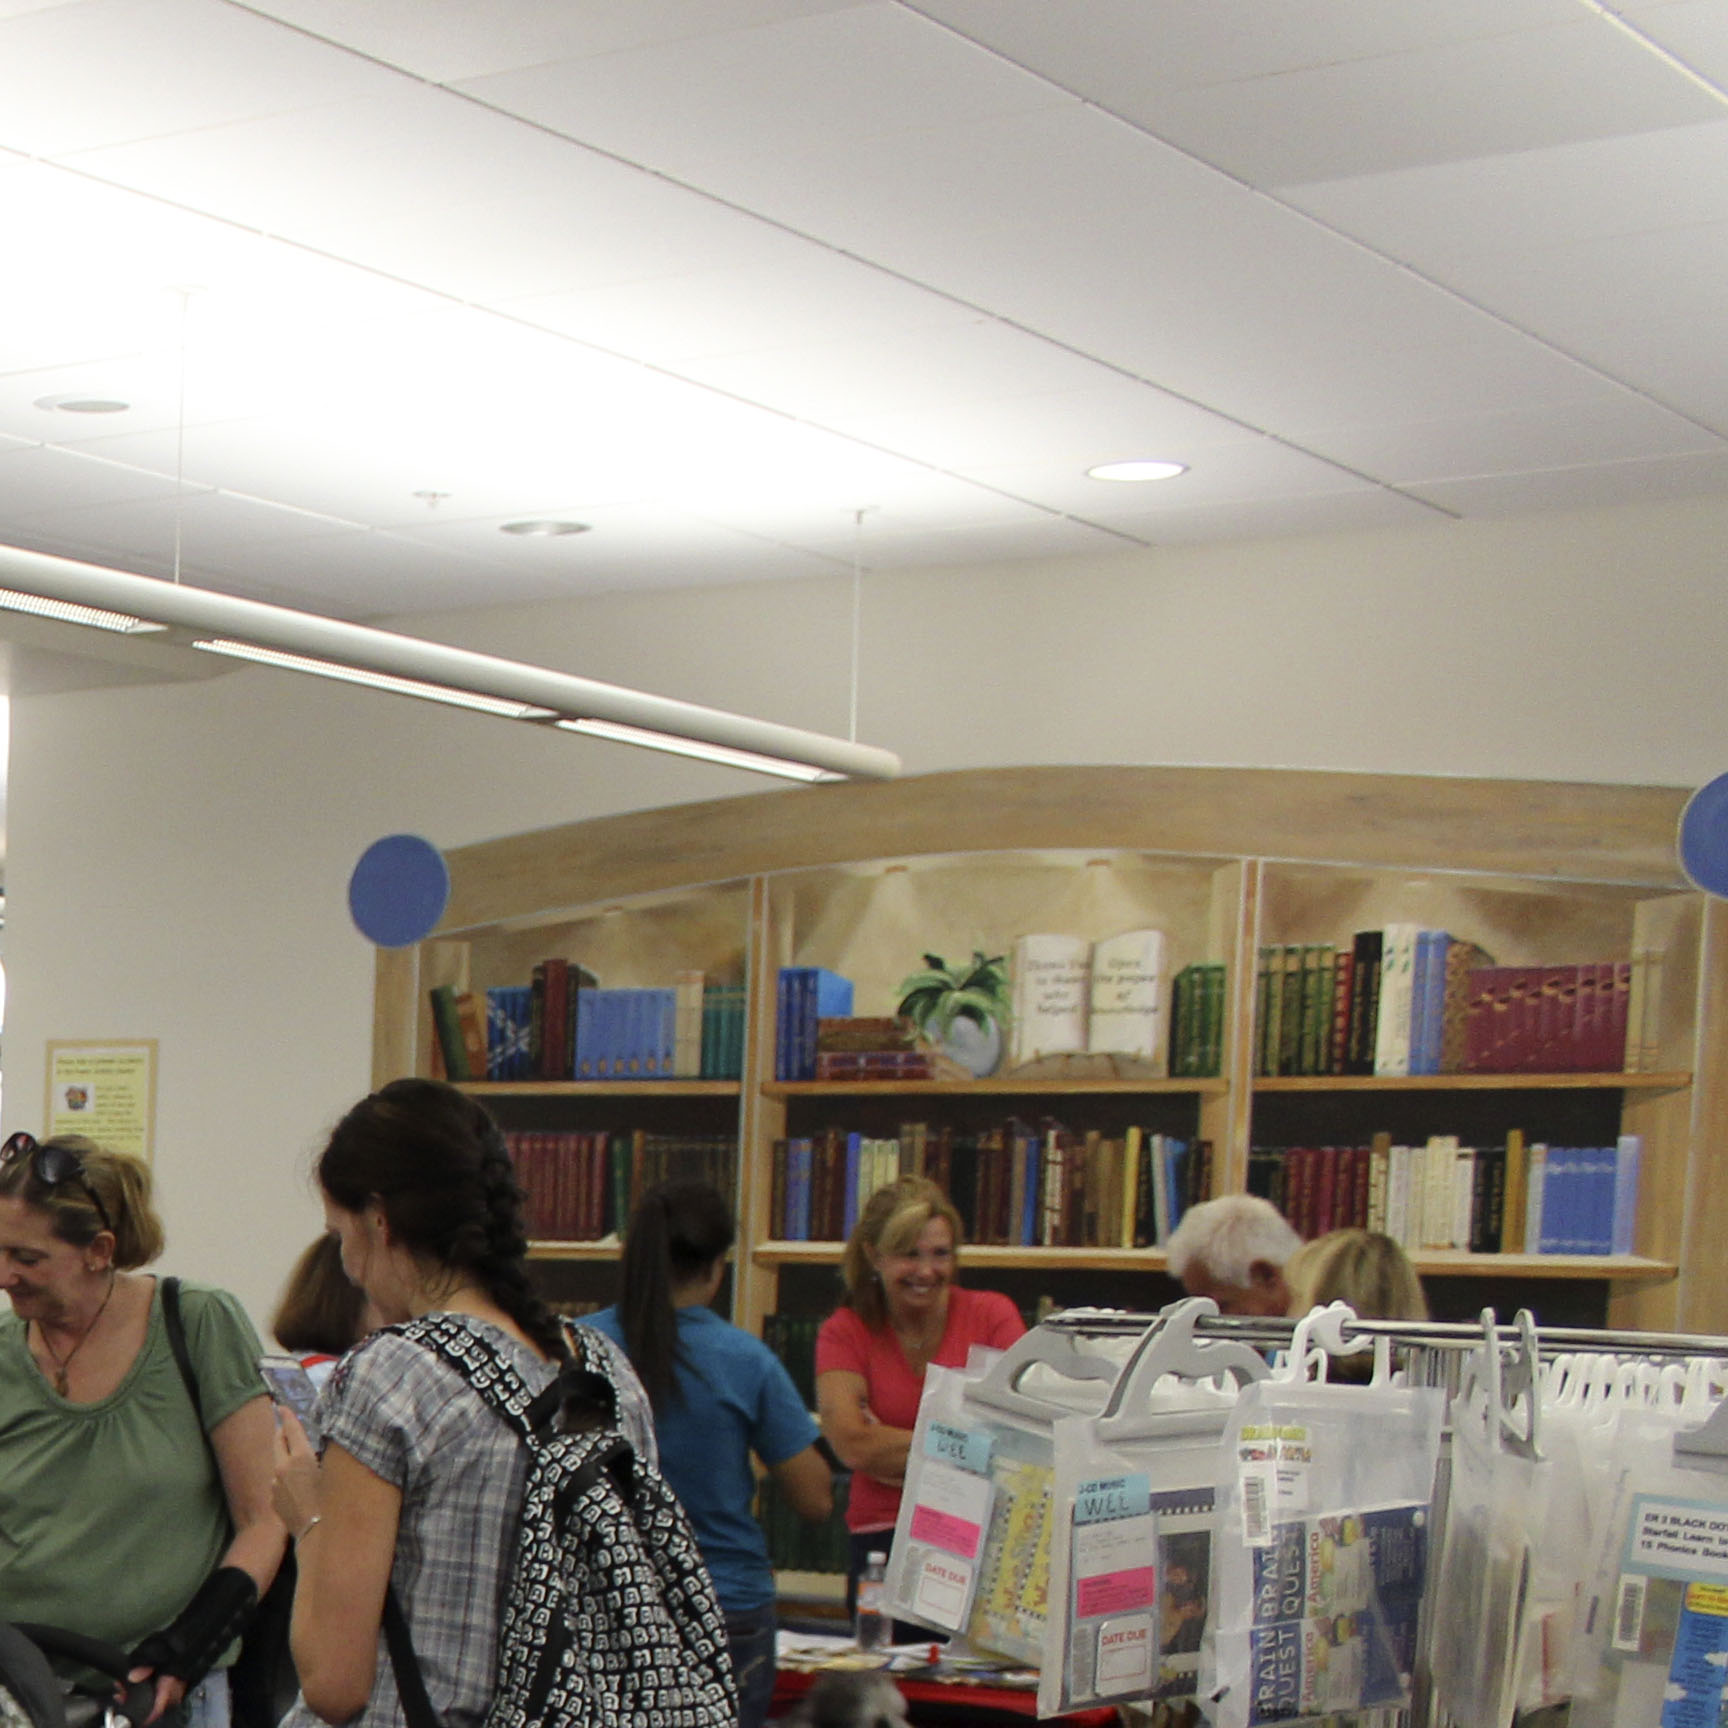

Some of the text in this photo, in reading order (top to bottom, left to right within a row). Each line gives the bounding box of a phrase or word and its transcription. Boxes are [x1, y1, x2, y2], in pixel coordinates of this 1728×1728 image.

[1099, 1478, 1126, 1491] MUSIC
[1670, 1517, 1706, 1529] BLACK
[1656, 1542, 1697, 1556] Phonics
[925, 1562, 967, 1586] DATE DUE
[1308, 1531, 1320, 1604] America
[1102, 1628, 1147, 1647] DATE DUE
